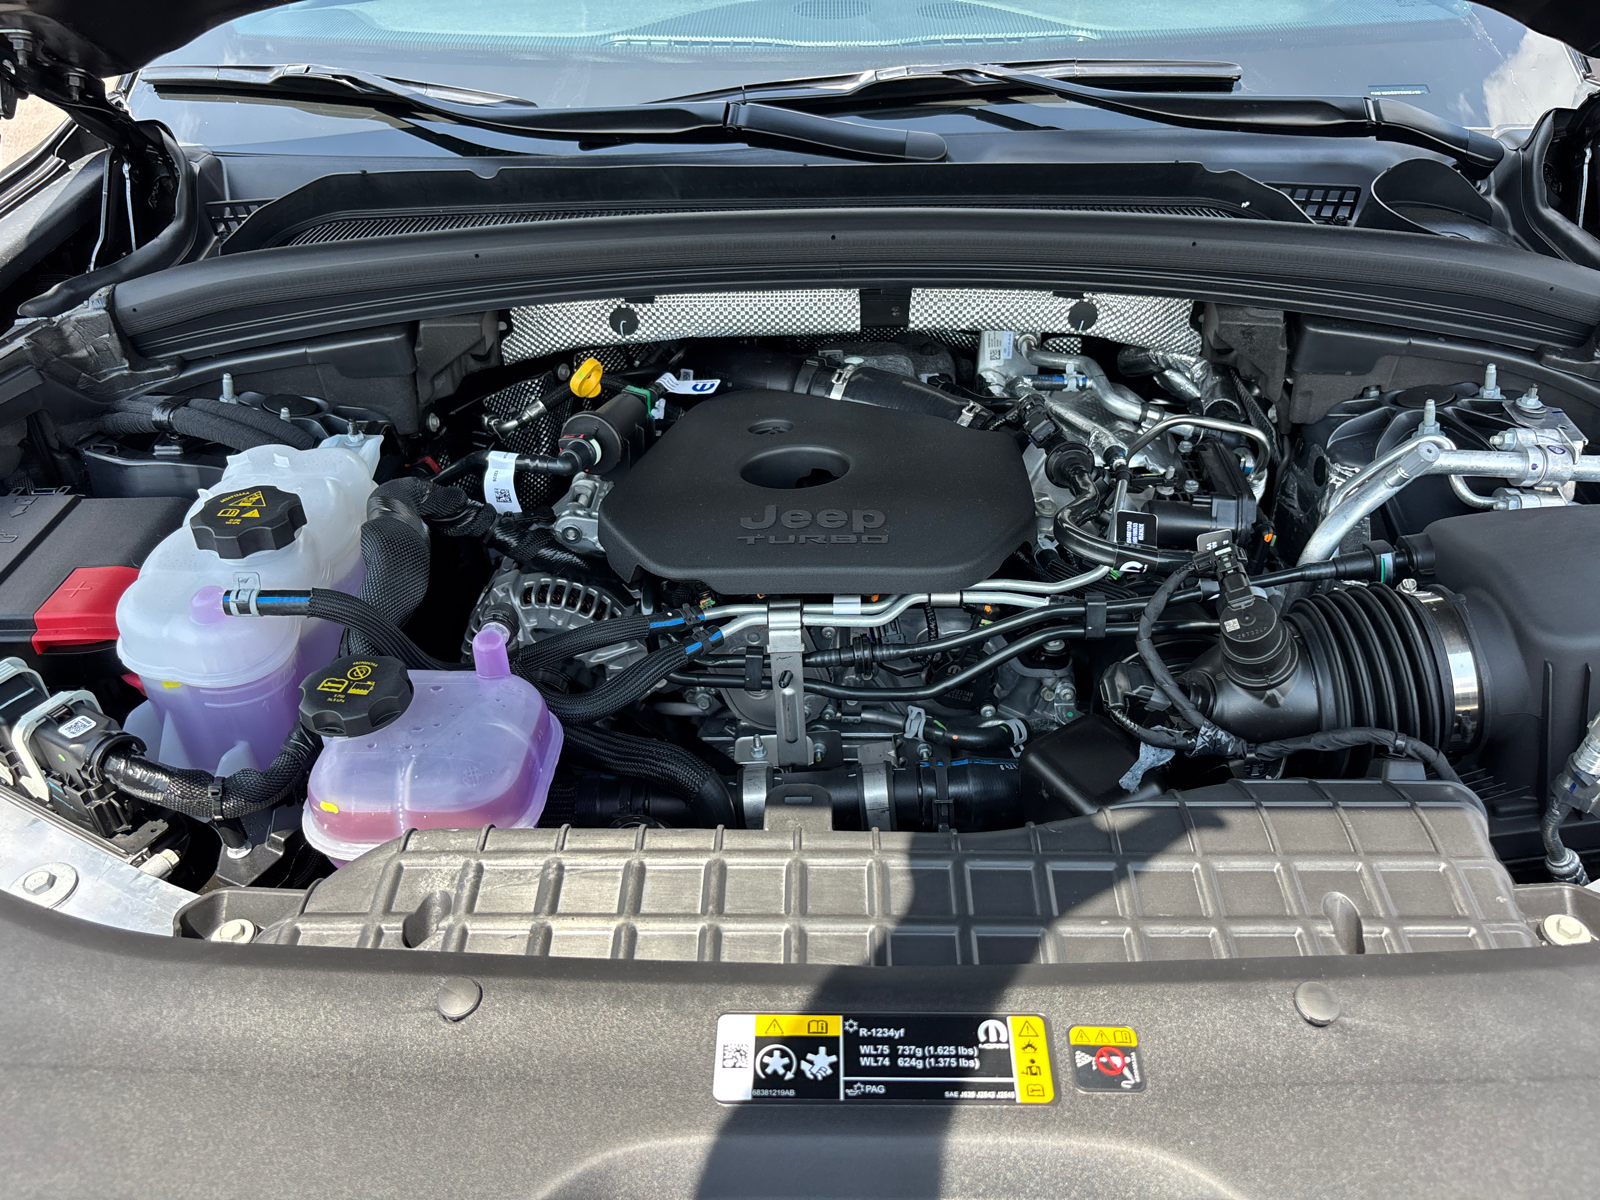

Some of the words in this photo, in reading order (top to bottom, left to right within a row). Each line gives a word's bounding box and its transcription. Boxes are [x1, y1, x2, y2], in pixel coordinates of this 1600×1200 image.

[740, 504, 886, 533] Jeep
[737, 534, 889, 545] TURBO
[859, 1027, 905, 1039] R-1234yf
[860, 1045, 889, 1055] WL75
[897, 1045, 922, 1057] 737g
[924, 1045, 956, 1057] (1.625
[958, 1045, 978, 1057] lbs)
[860, 1057, 890, 1067] WL74
[898, 1058, 923, 1069] 624g
[926, 1057, 957, 1069] (1.375
[959, 1057, 980, 1070] lbs)
[752, 1089, 795, 1097] 68381219AB
[865, 1085, 885, 1094] PAG
